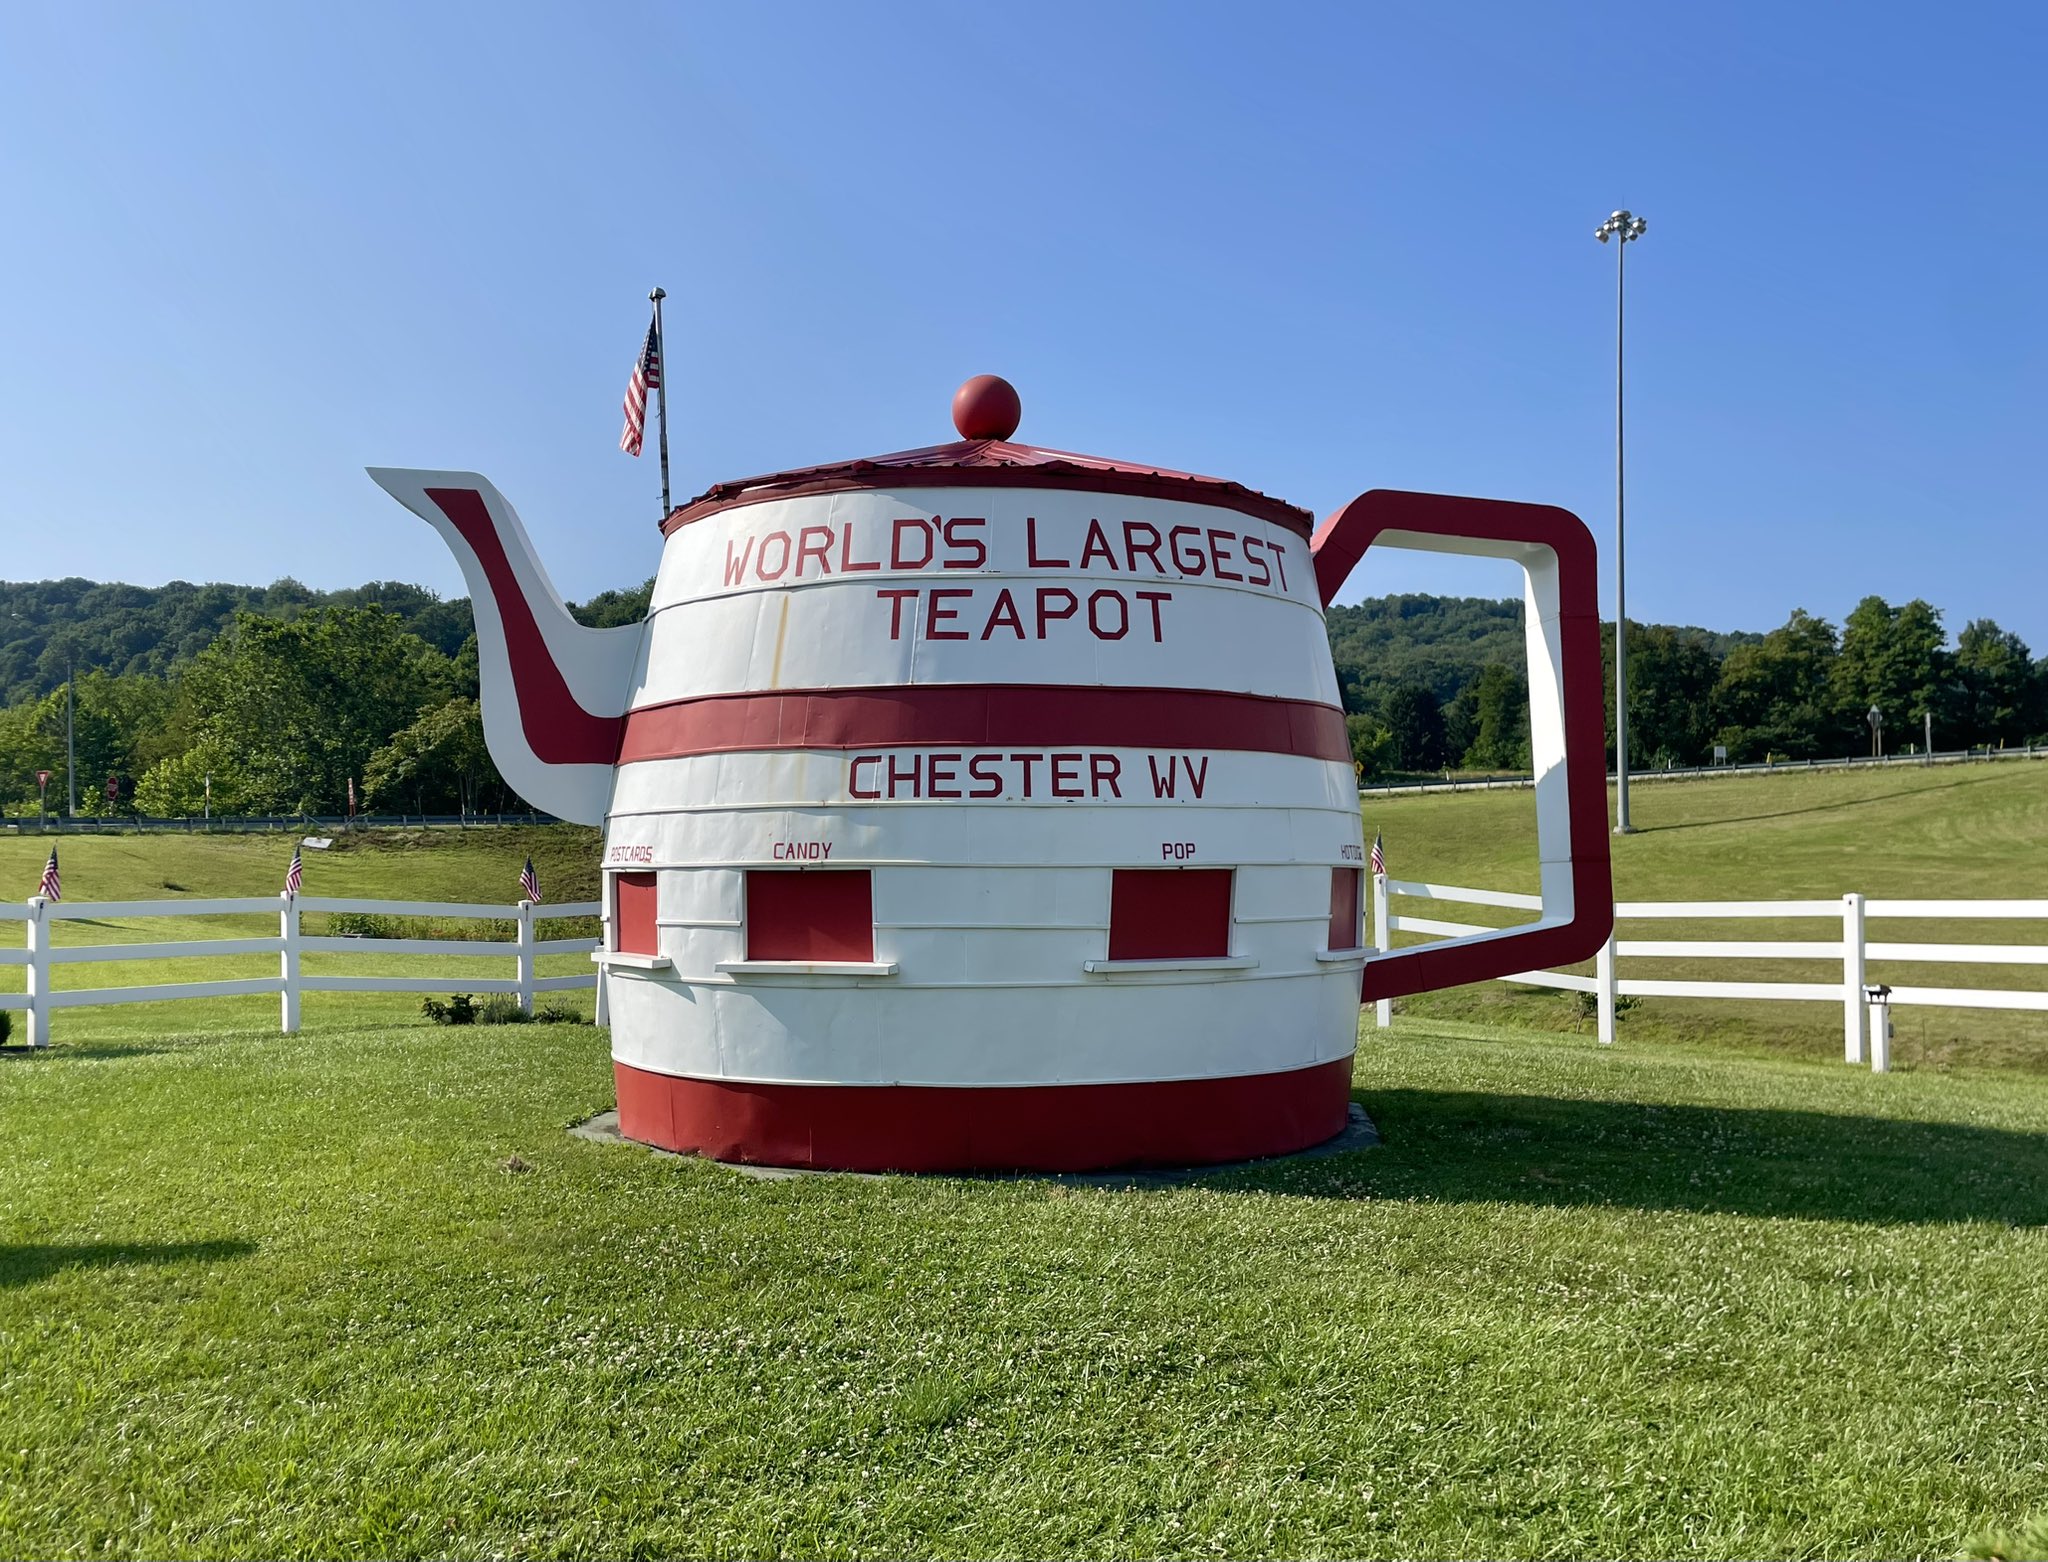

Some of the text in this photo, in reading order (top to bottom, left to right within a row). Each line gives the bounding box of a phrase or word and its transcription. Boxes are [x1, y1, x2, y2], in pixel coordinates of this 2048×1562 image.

[724, 515, 1287, 592] WORLD'S LARGEST
[877, 588, 1172, 642] TEAPOT
[849, 753, 1208, 799] CHESTER WV
[610, 845, 653, 862] POSTCARDS
[773, 842, 832, 859] CANDY
[1162, 843, 1195, 860] POP
